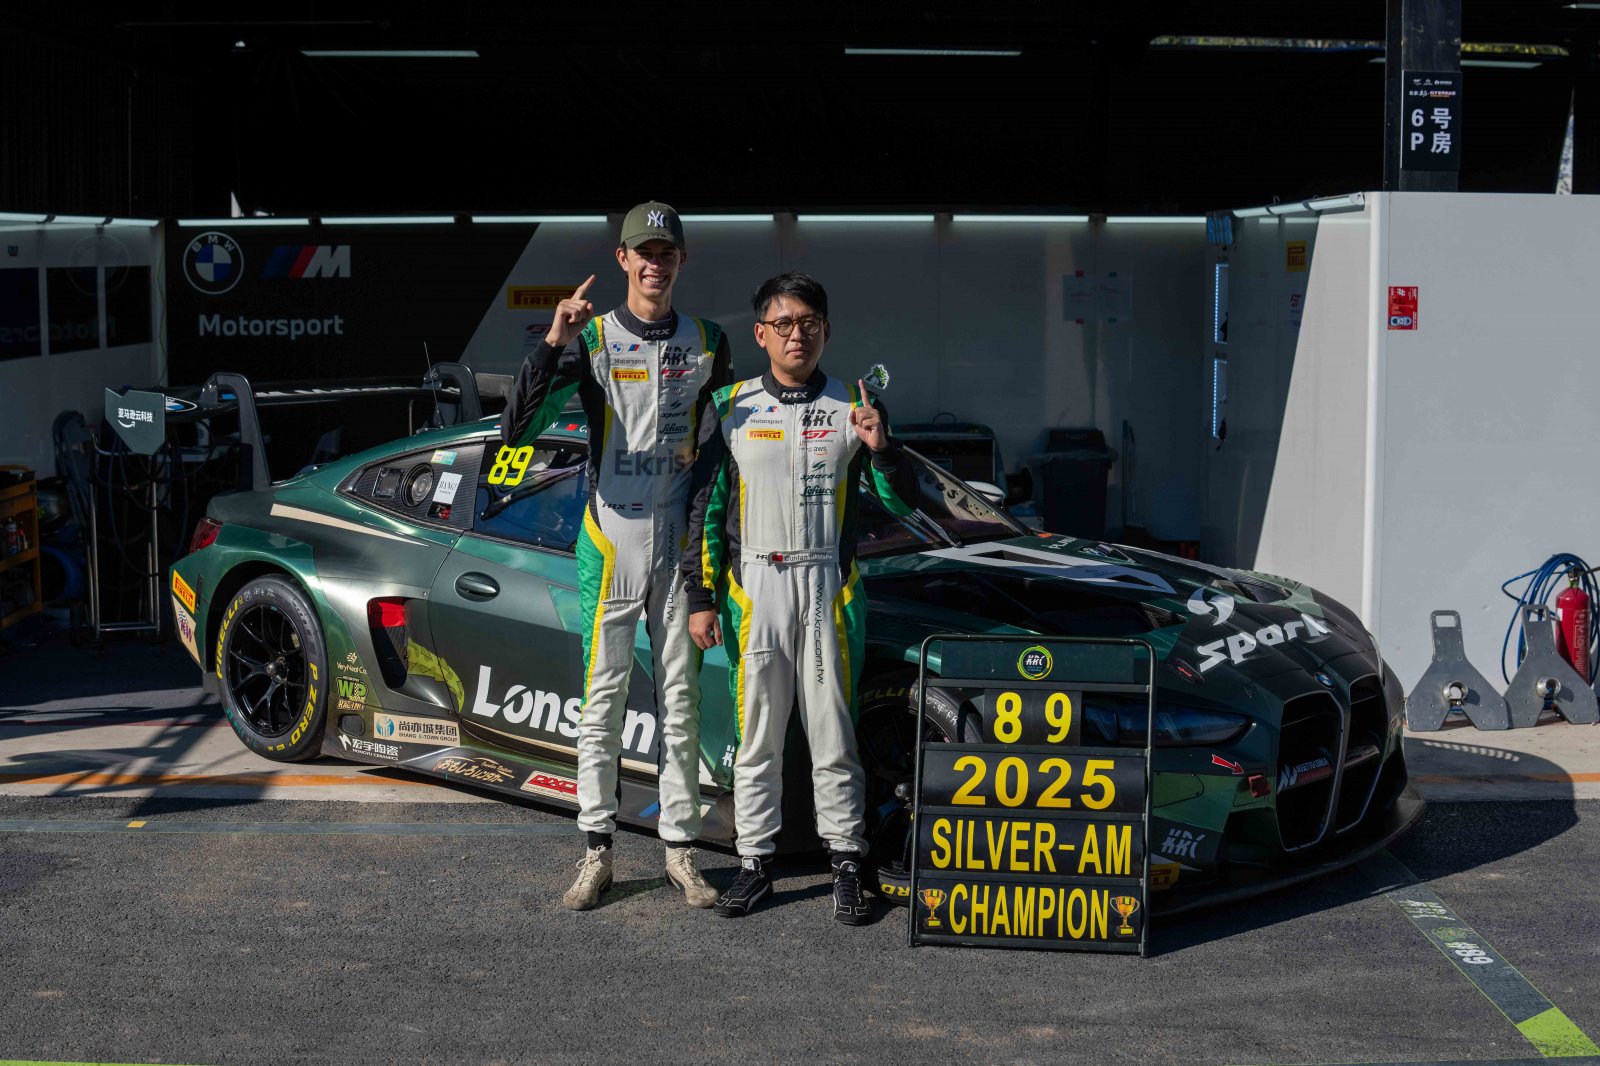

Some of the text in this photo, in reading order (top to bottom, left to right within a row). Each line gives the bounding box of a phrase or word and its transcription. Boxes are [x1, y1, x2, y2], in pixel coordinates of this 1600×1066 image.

[1411, 107, 1452, 129] 6 号
[1410, 130, 1452, 154] P 房
[198, 313, 345, 341] Motorsport
[614, 370, 646, 380] PIRELLI
[488, 444, 534, 487] 89
[614, 449, 691, 477] Ekris
[289, 684, 318, 745] ZERO
[472, 665, 658, 755] Lonsn
[951, 755, 1117, 810] 2025
[930, 818, 1132, 875] SILVER-AM
[949, 883, 1109, 940] CHAMPION
